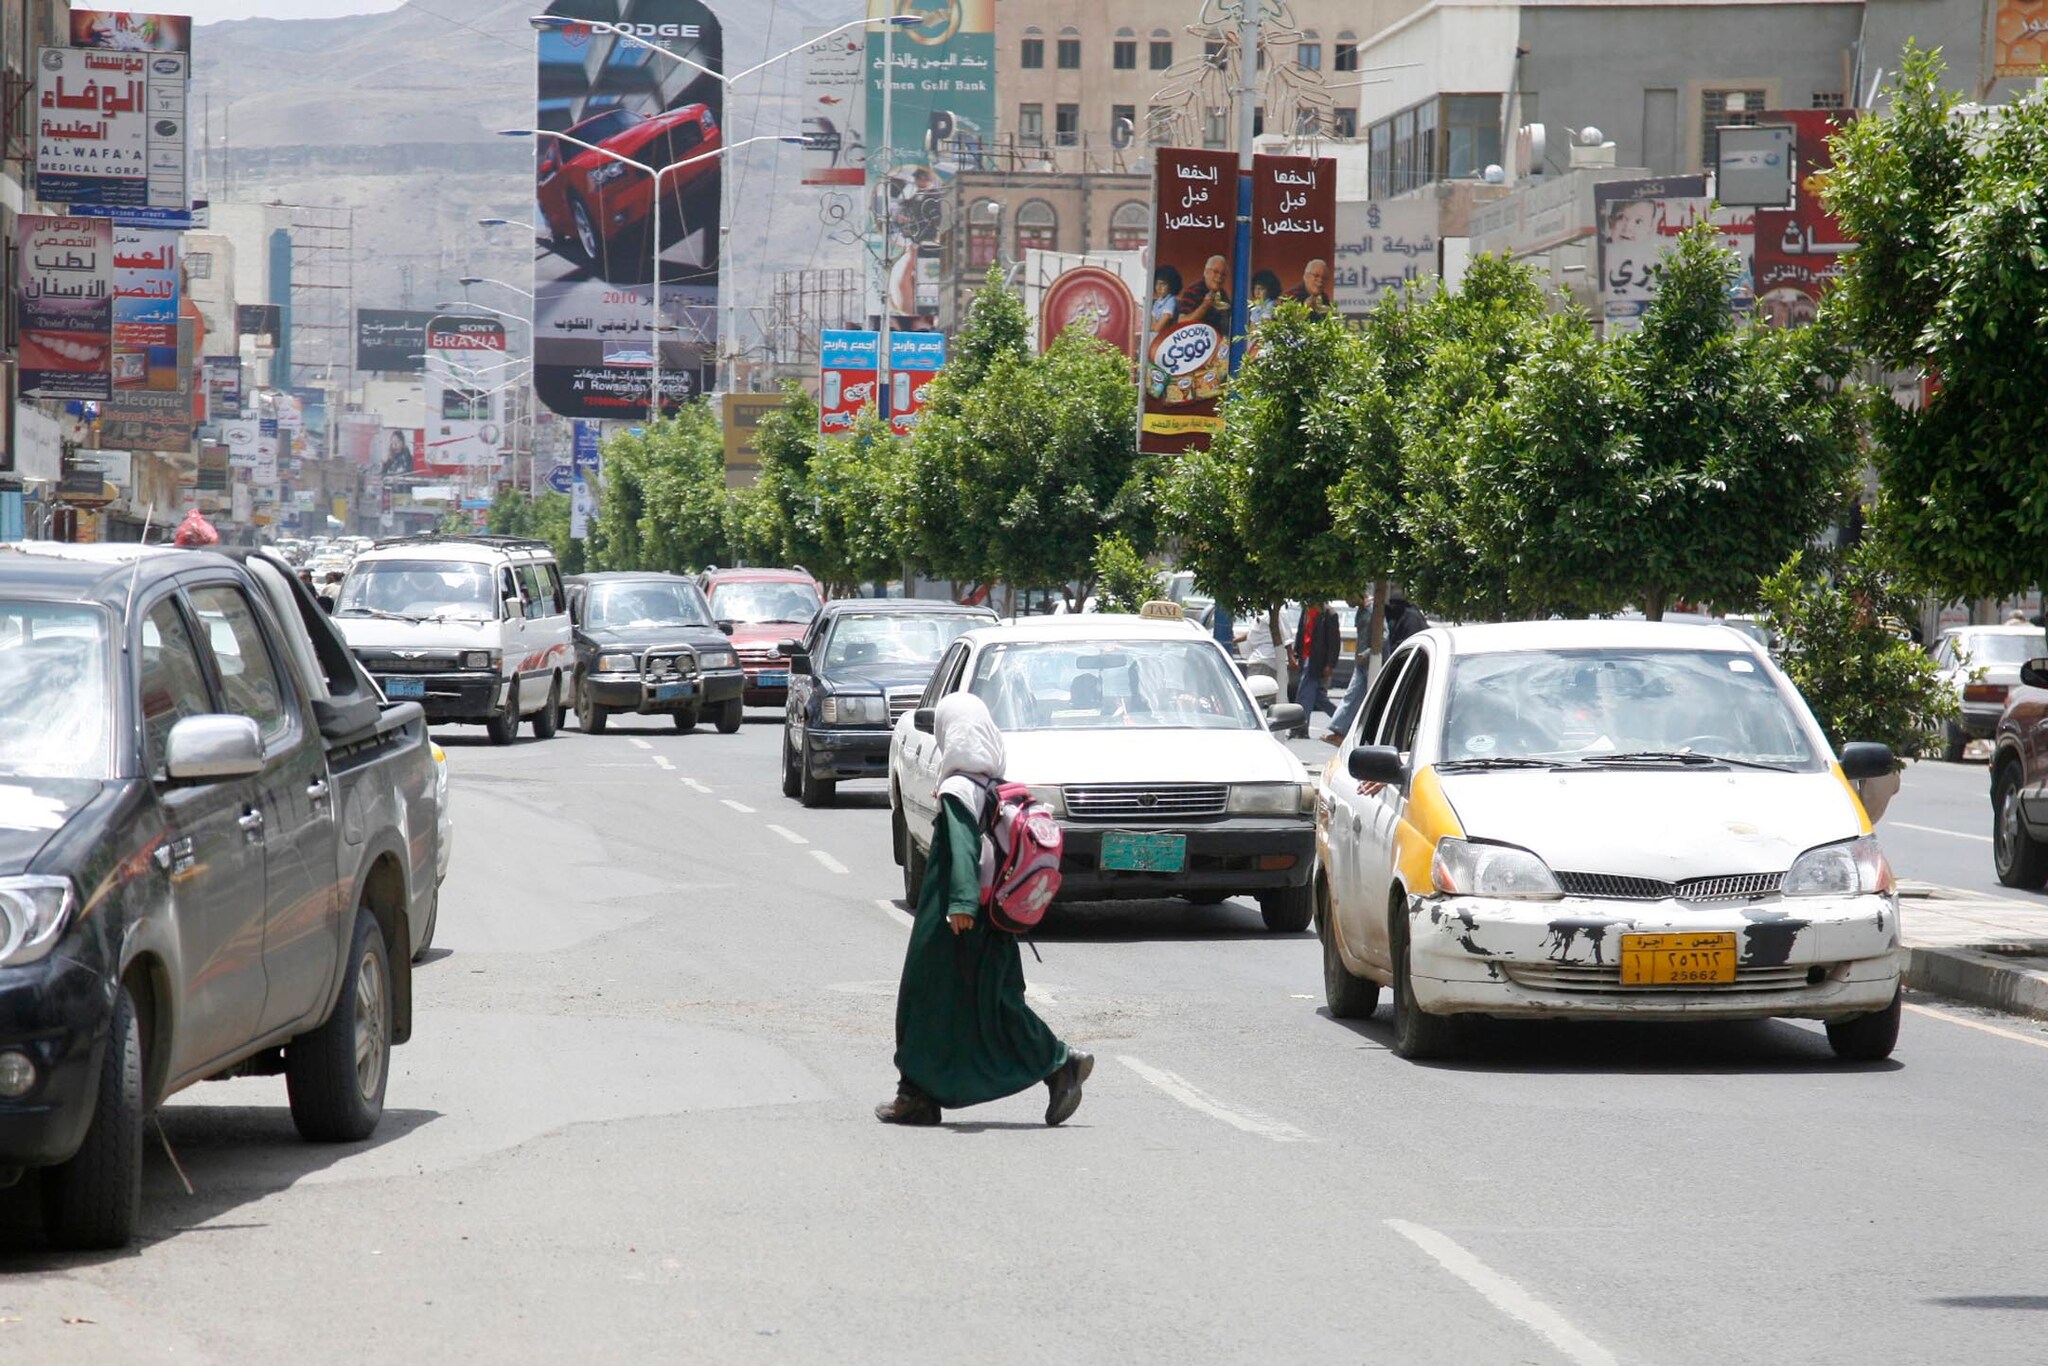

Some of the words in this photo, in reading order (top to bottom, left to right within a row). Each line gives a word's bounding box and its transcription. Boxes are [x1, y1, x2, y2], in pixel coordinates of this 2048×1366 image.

[591, 22, 700, 38] DODGE
[85, 53, 144, 75] مؤسسة
[873, 53, 919, 69] والخلج
[921, 54, 957, 70] اليمن
[960, 57, 988, 70] بنك
[921, 79, 948, 91] Gulf
[955, 79, 987, 91] Bank
[42, 76, 144, 118] الوفاء
[42, 119, 107, 142] الطبية
[41, 146, 142, 160] AL-WAFA'A
[40, 163, 98, 173] MEDICAL
[1177, 164, 1218, 185] إلحقها
[1274, 170, 1316, 189] إلحقها
[1182, 186, 1208, 208] قبل
[1280, 191, 1307, 213] قبل
[1335, 236, 1372, 258] الصي
[1383, 234, 1434, 258] شركة
[35, 252, 96, 276] لطب
[25, 276, 105, 300] الأسنان
[603, 292, 637, 304] 2010
[458, 324, 496, 332] SONY
[554, 317, 593, 333] القلوب
[432, 334, 499, 348] BRAVIA
[1172, 326, 1206, 344] NOODY
[573, 380, 584, 390] Al
[590, 381, 646, 392] Rowaishan
[655, 383, 689, 393] otors
[108, 391, 182, 408] elecome
[1149, 604, 1176, 616] TAXI
[1692, 935, 1724, 947] اليمن
[1668, 951, 1721, 967] ٢٥٦٦٢
[1671, 970, 1718, 981] 25662
